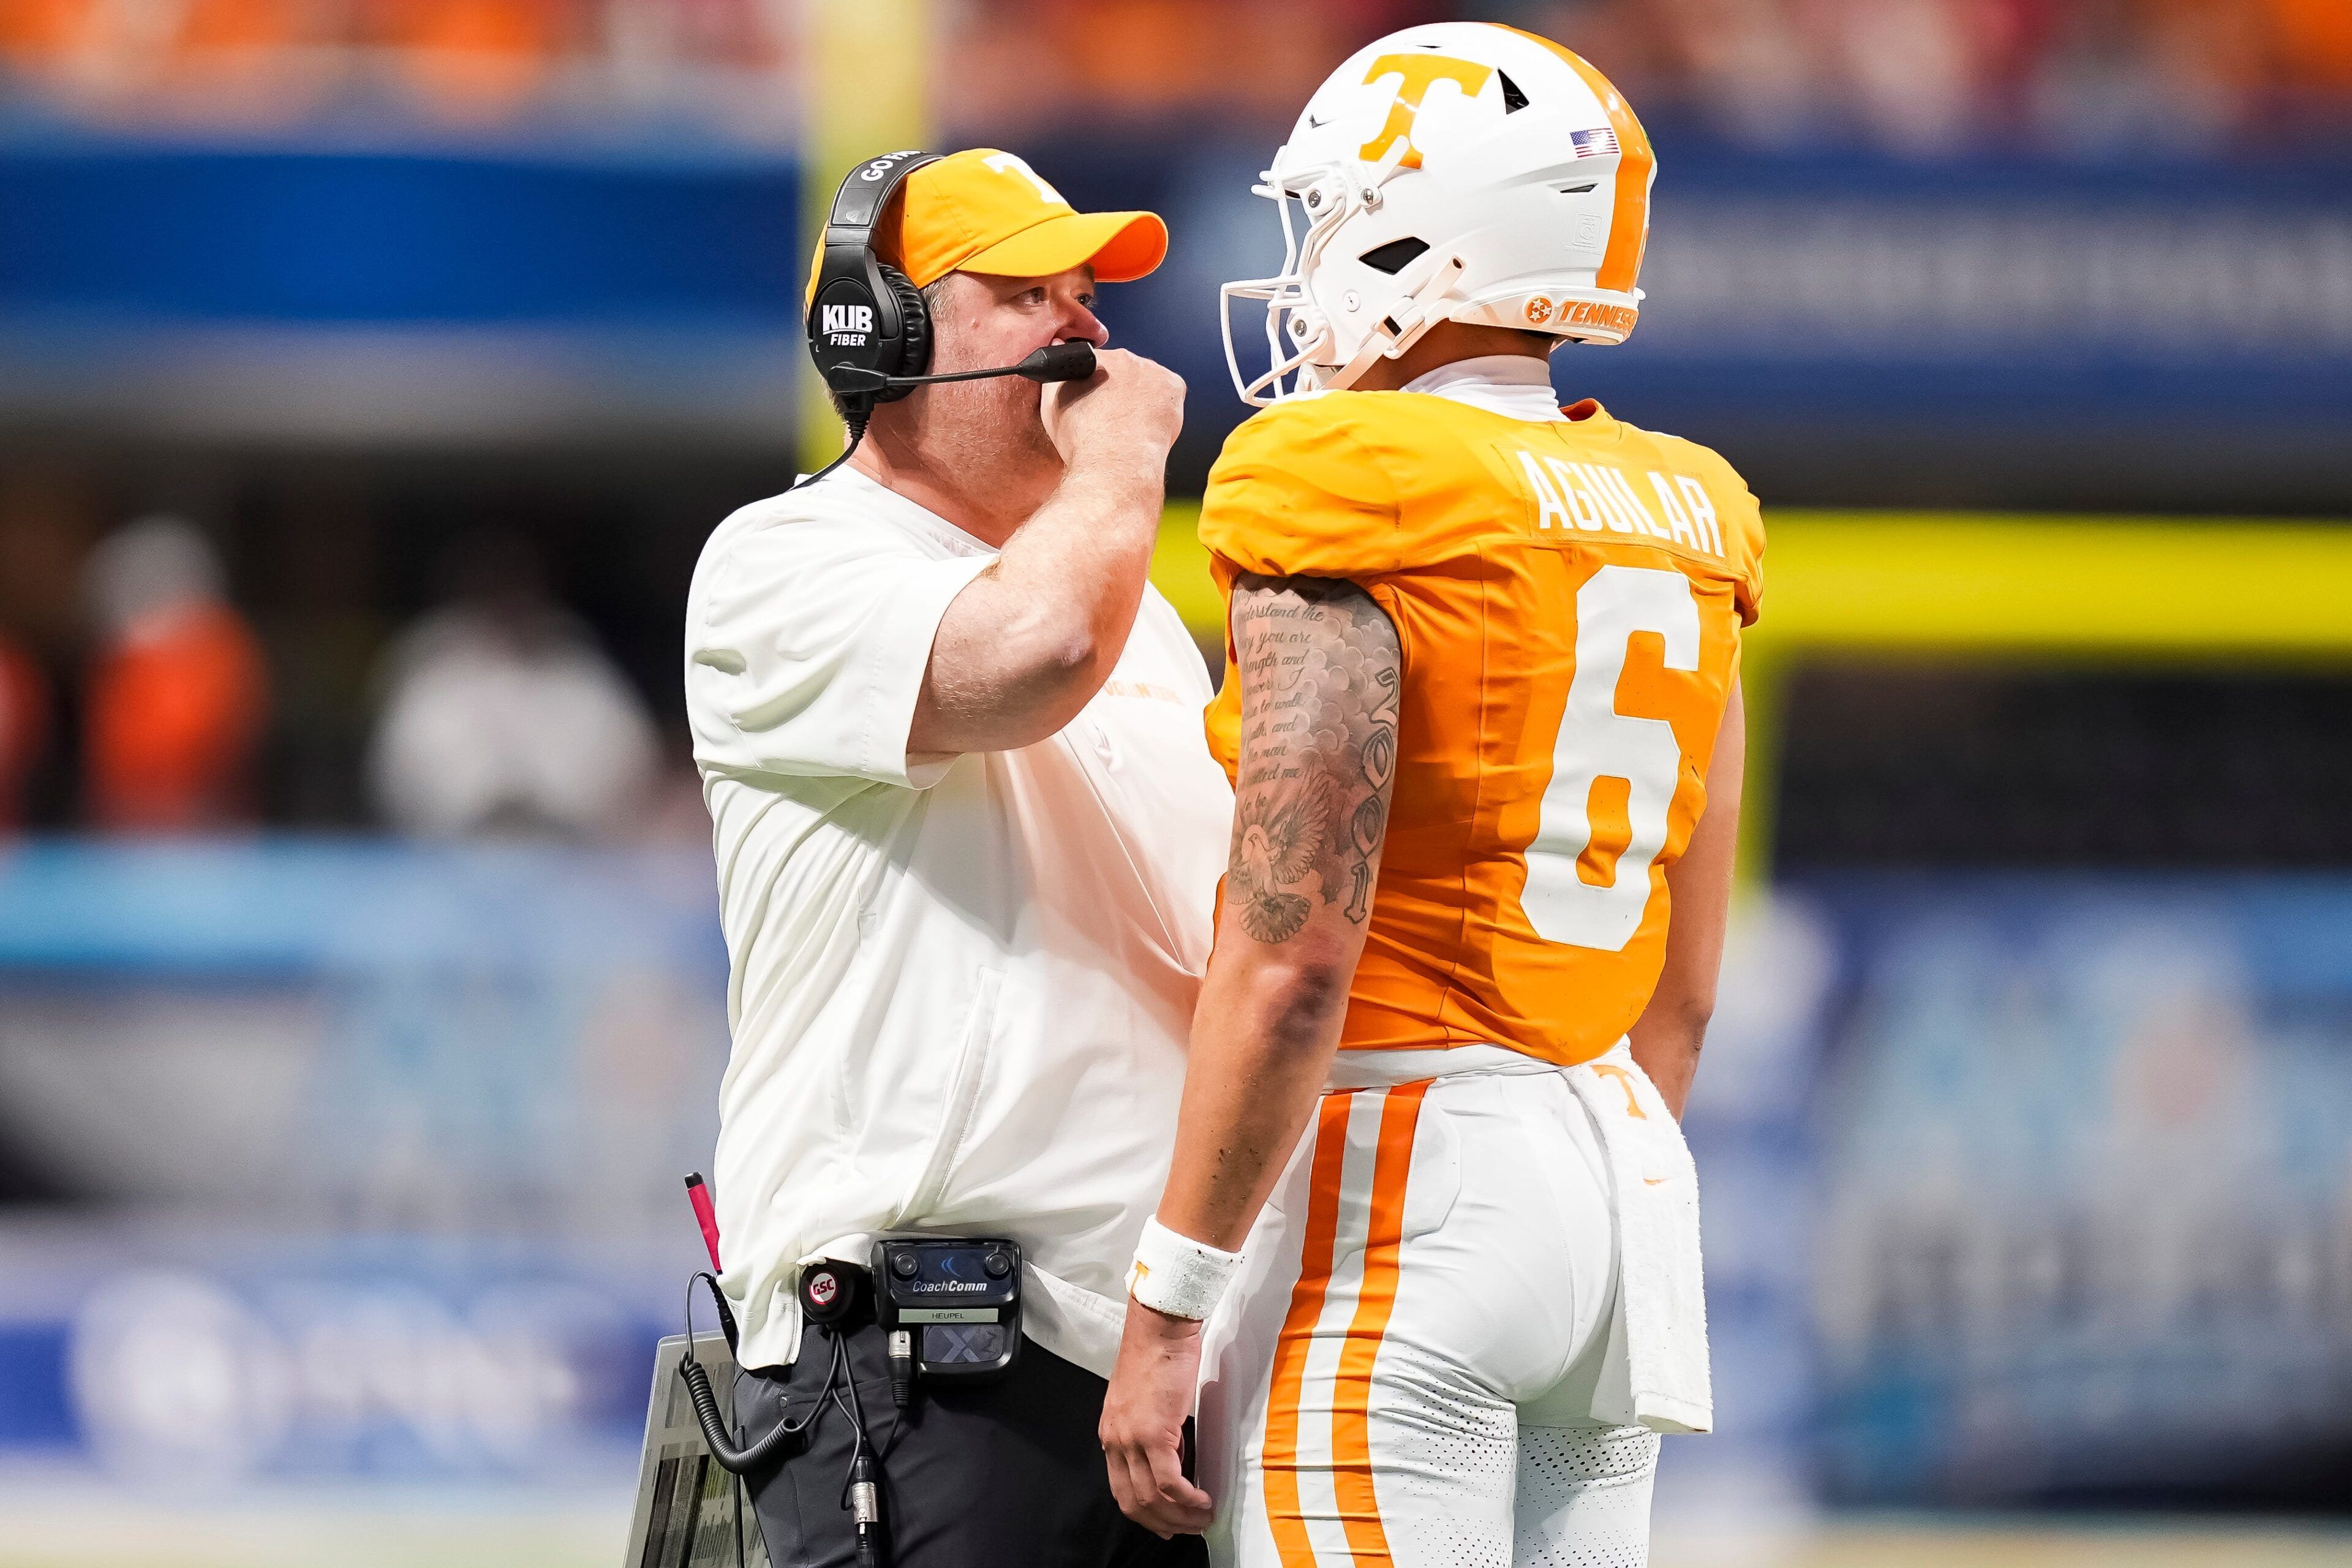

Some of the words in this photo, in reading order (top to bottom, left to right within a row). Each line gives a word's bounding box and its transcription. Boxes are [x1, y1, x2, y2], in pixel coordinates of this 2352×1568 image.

[1359, 53, 1494, 169] T
[861, 160, 893, 181] GO
[823, 305, 873, 333] KUB
[830, 334, 866, 346] FIBER
[1516, 451, 1725, 557] AGUILAR
[1256, 631, 1284, 654] you
[1282, 648, 1310, 665] and
[1272, 714, 1298, 733] and
[1519, 565, 1700, 952] 6
[813, 1278, 835, 1295] GSC
[913, 1280, 987, 1292] CoachComm
